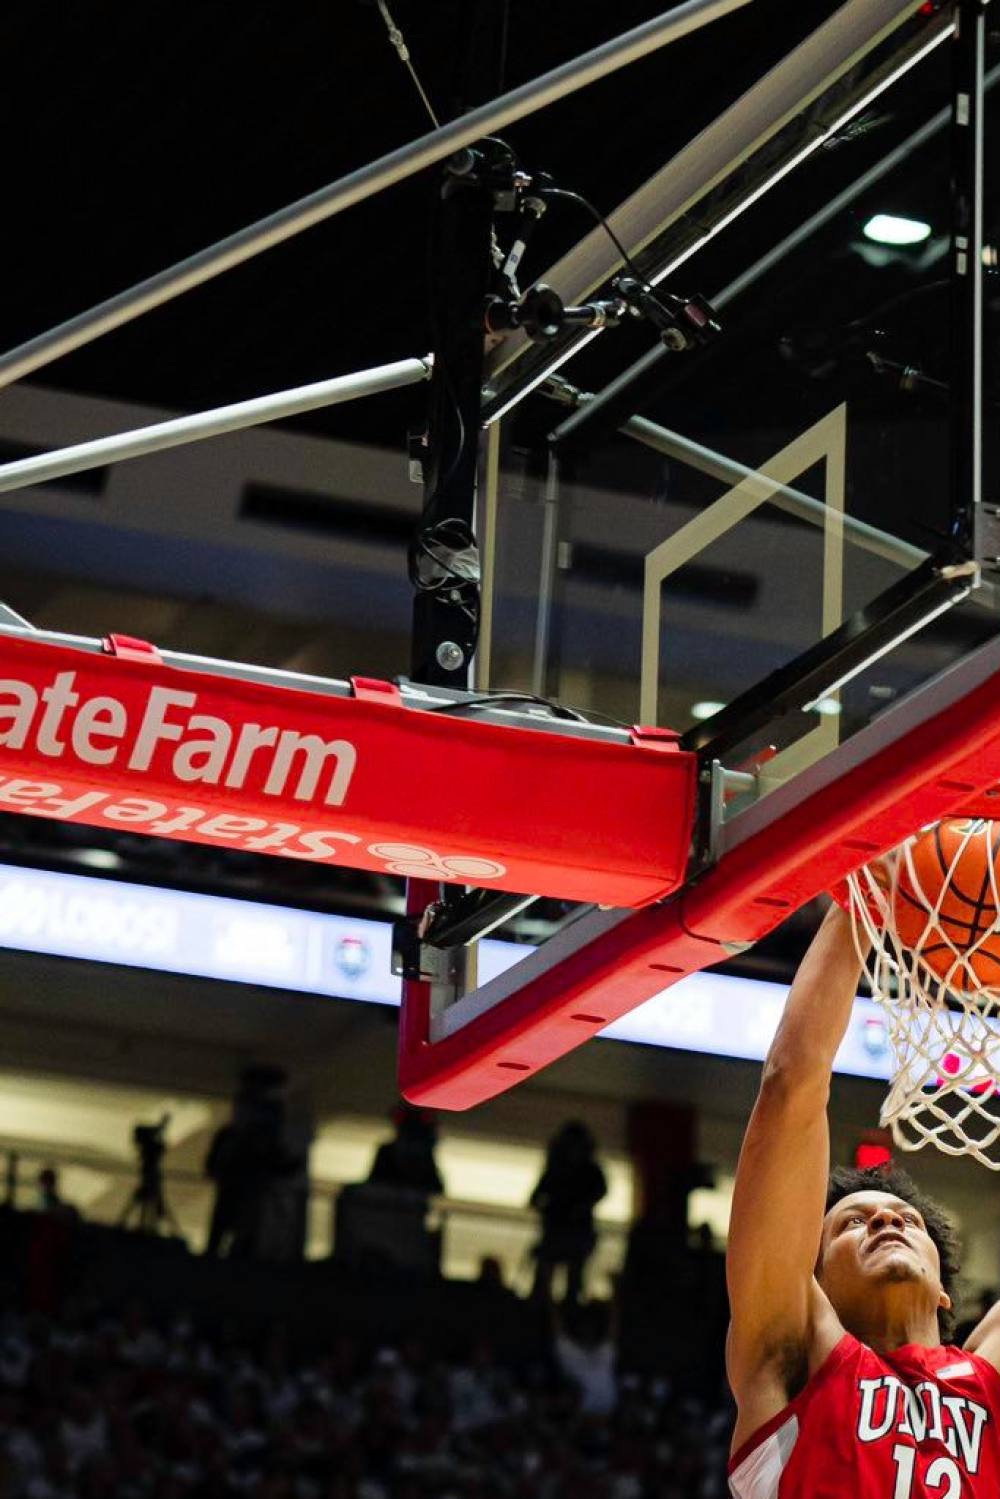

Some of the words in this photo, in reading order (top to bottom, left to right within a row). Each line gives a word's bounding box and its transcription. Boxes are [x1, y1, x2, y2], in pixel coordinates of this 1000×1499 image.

[128, 686, 357, 806] Farm
[0, 777, 111, 819] Fa
[102, 799, 364, 860] State
